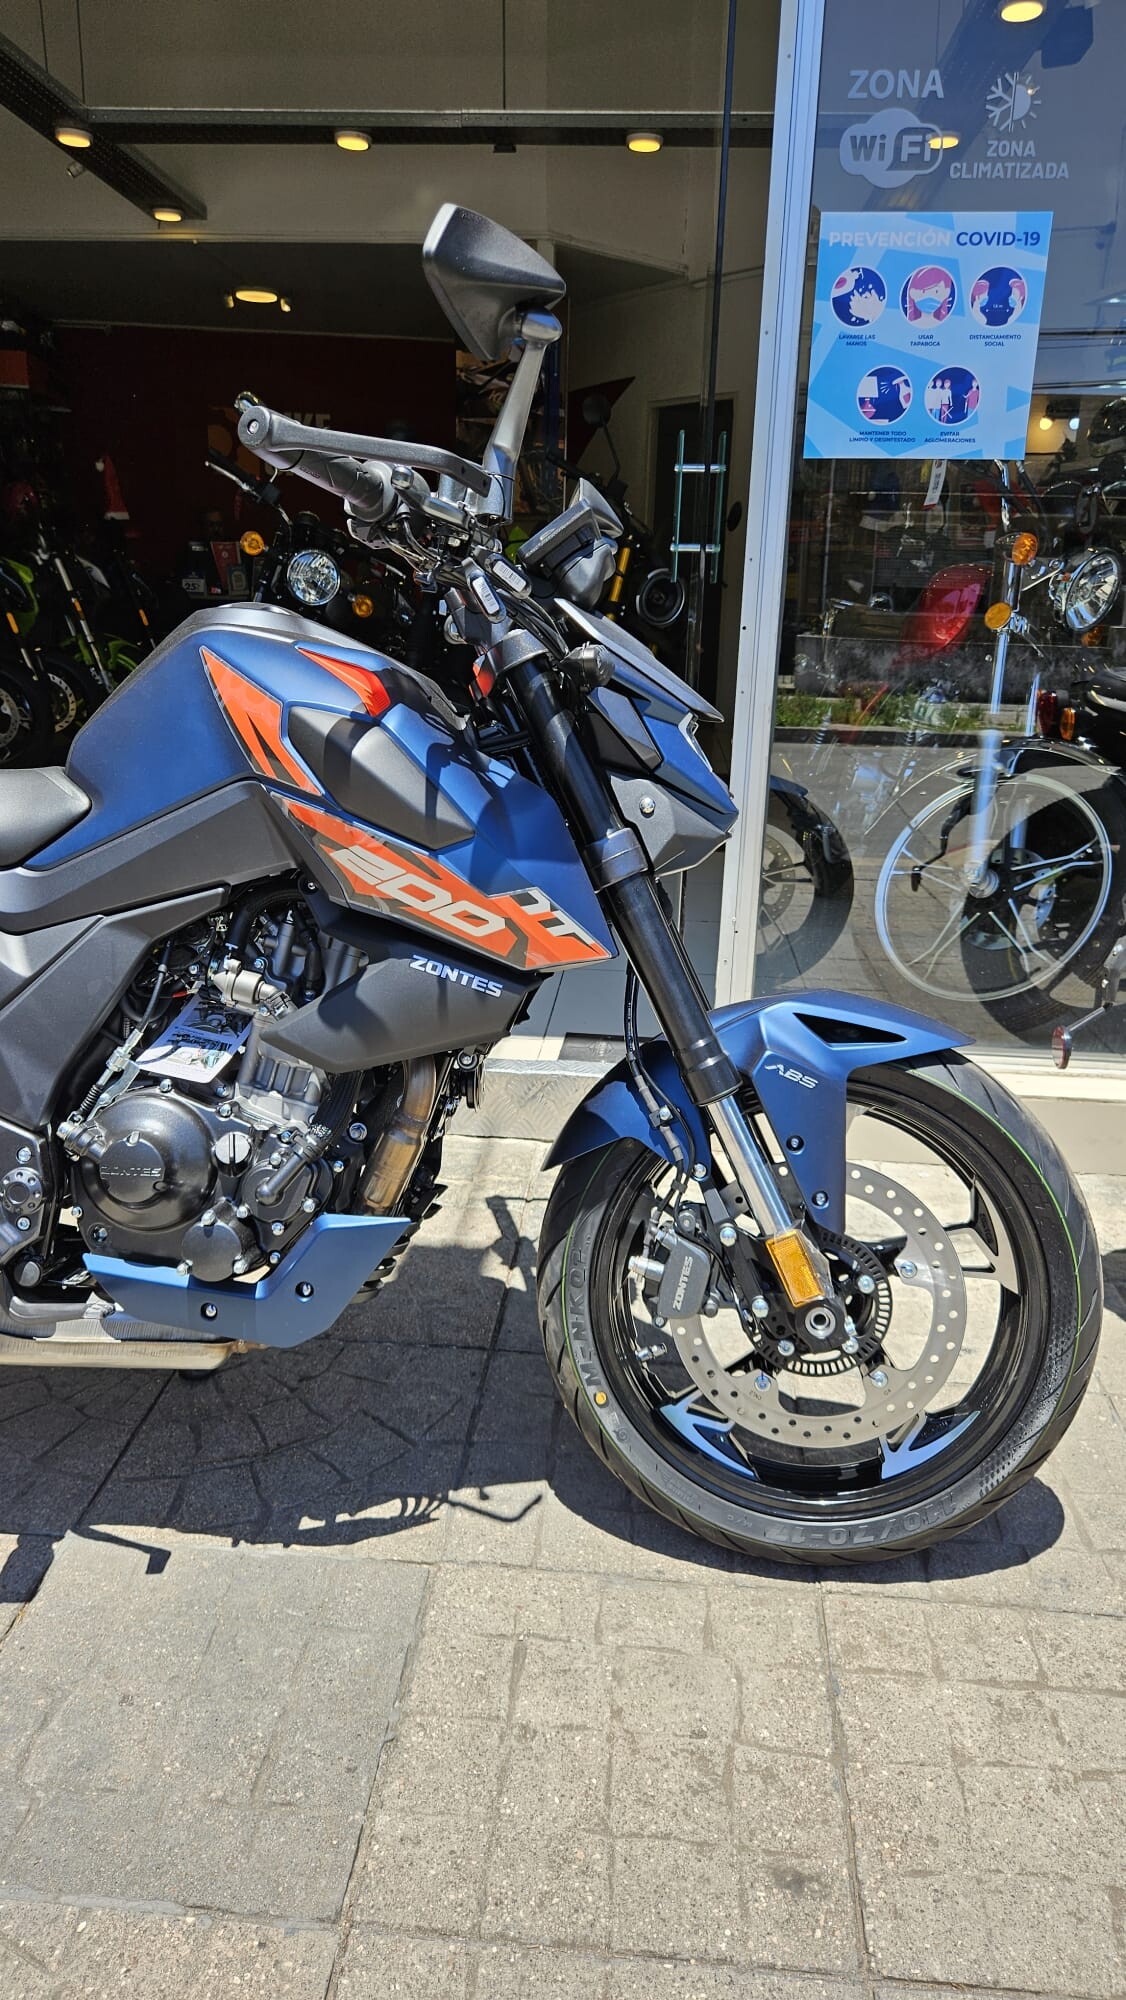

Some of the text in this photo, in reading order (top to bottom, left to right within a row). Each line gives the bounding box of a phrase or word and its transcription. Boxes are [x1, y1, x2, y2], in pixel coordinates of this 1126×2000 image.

[847, 68, 945, 100] ZONA
[849, 133, 933, 163] WiFi
[986, 139, 1036, 158] ZONA
[949, 161, 1070, 180] CLIMATIZADA
[828, 228, 1041, 248] PREVENCIÓN COVID-19
[328, 844, 508, 937] 200
[409, 954, 503, 998] ZONTES
[764, 1063, 819, 1089] ABS
[671, 1255, 694, 1311] ZONTES
